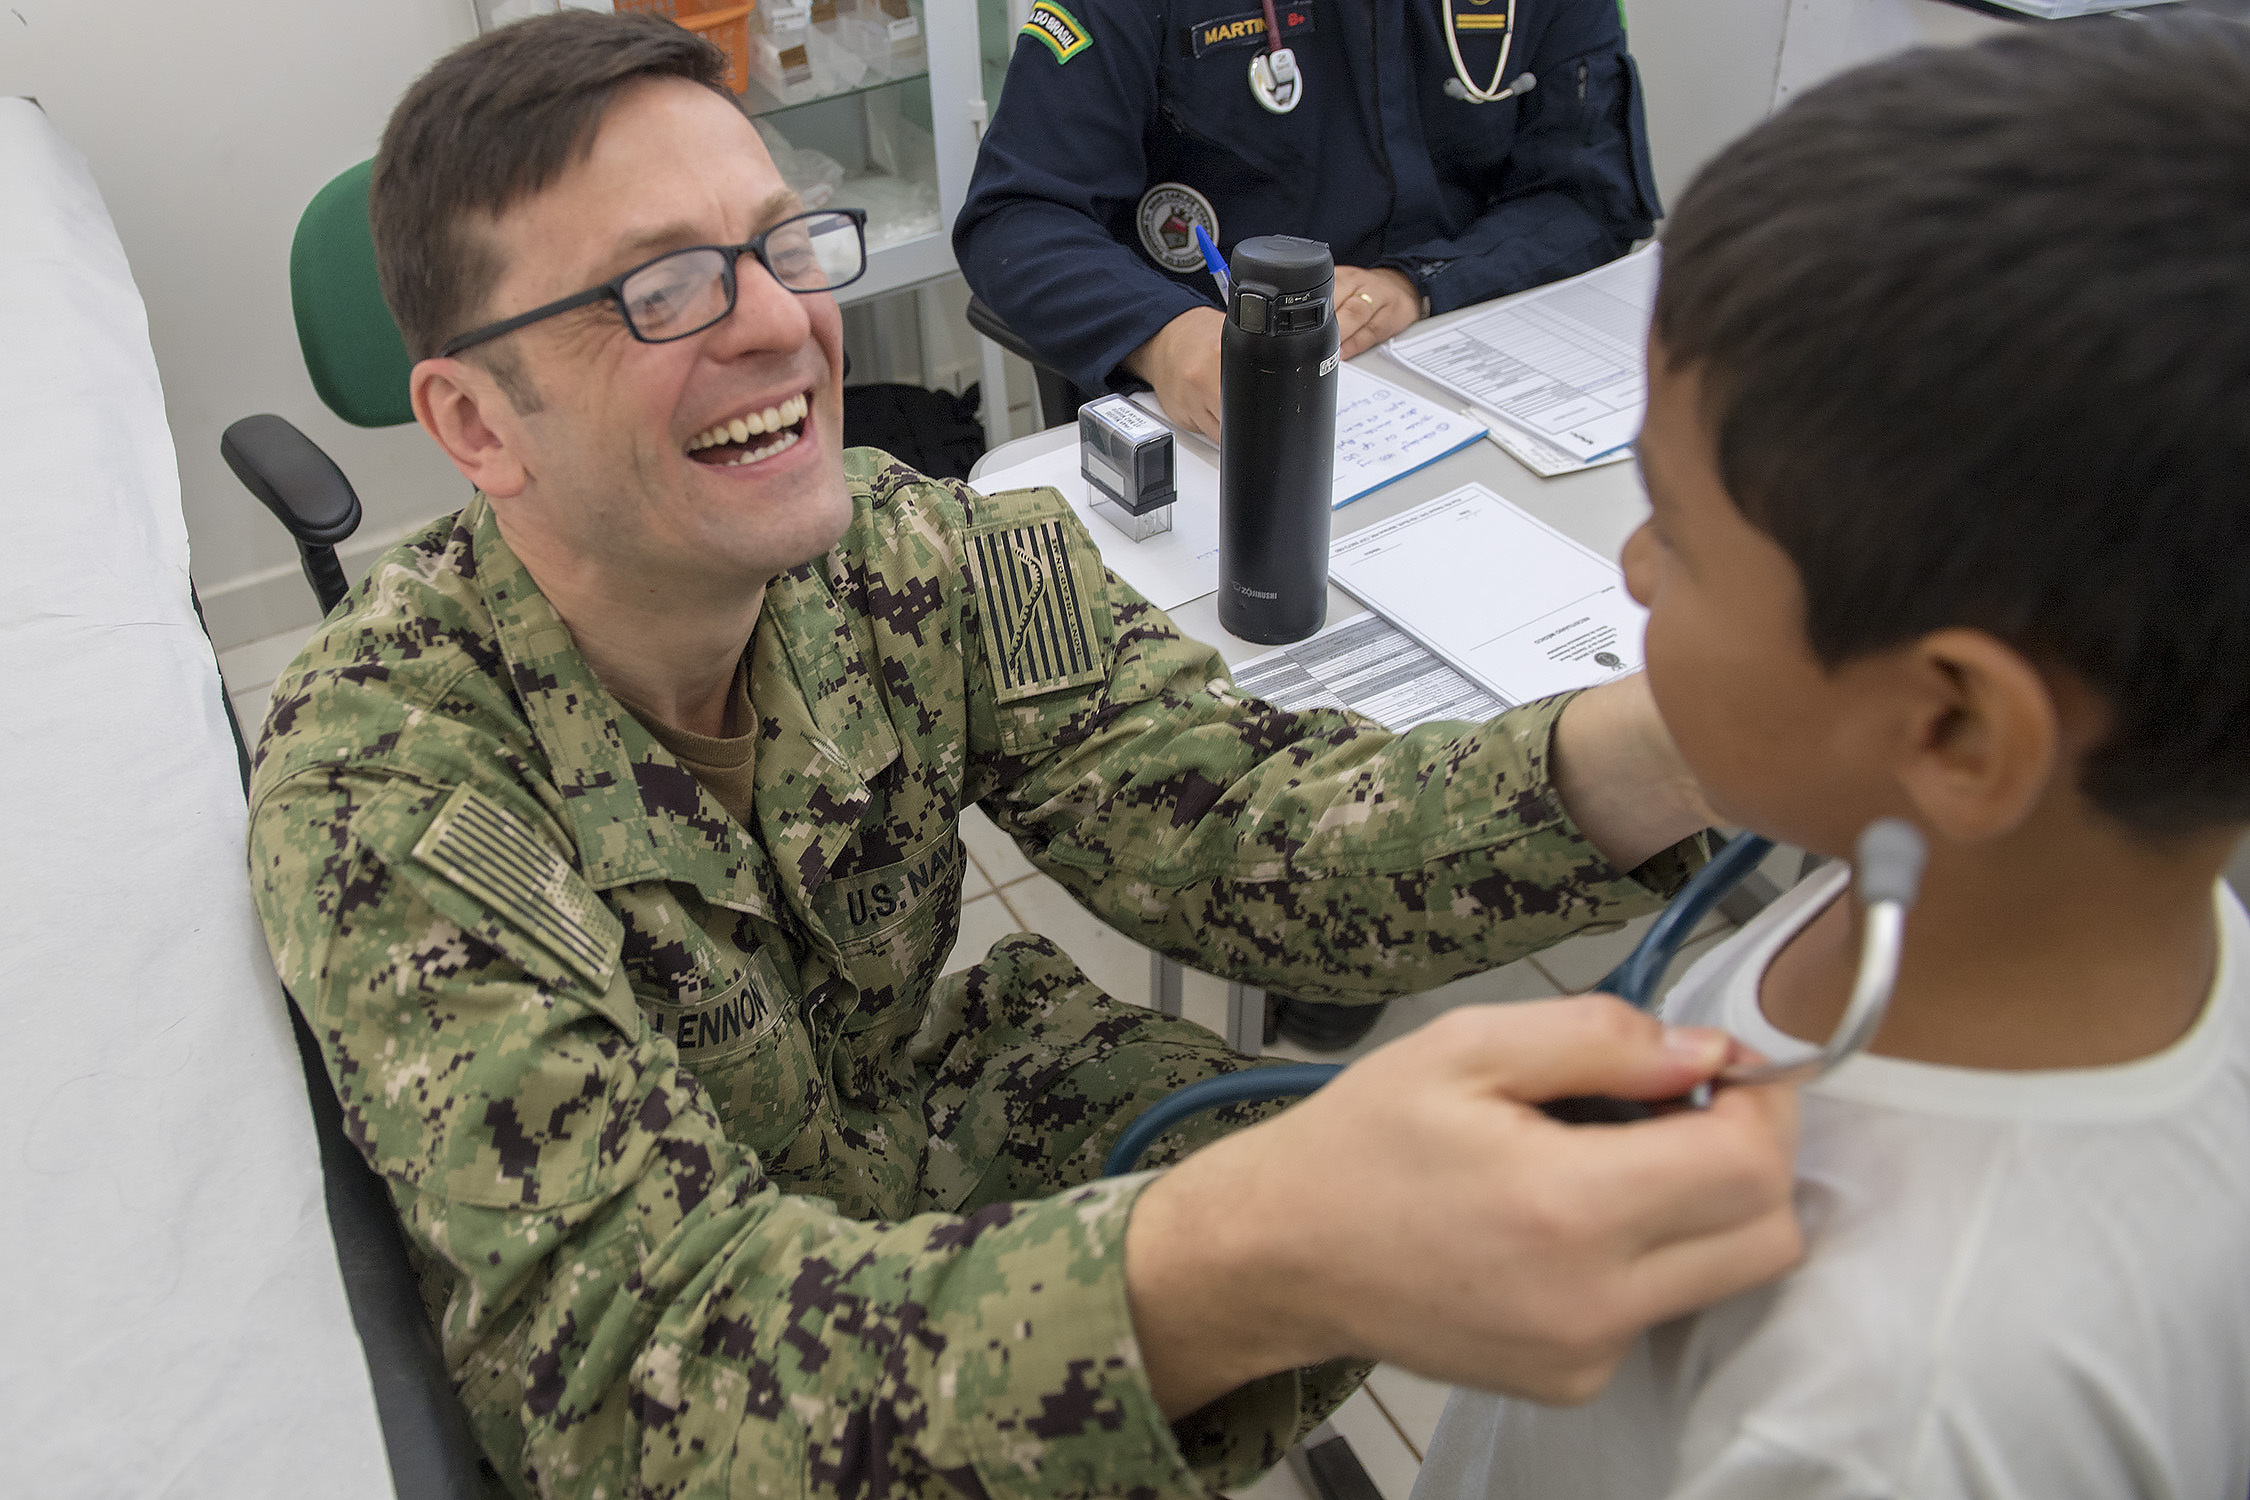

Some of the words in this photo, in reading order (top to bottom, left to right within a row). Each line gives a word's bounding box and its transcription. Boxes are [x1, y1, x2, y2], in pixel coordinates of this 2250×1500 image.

[1033, 10, 1049, 26] DO
[1045, 16, 1075, 50] BRASIL
[1204, 17, 1268, 46] MARTIN
[1056, 557, 1064, 574] ON
[1060, 576, 1073, 618] TREAD
[846, 882, 908, 927] U.S.
[906, 832, 956, 898] NAV
